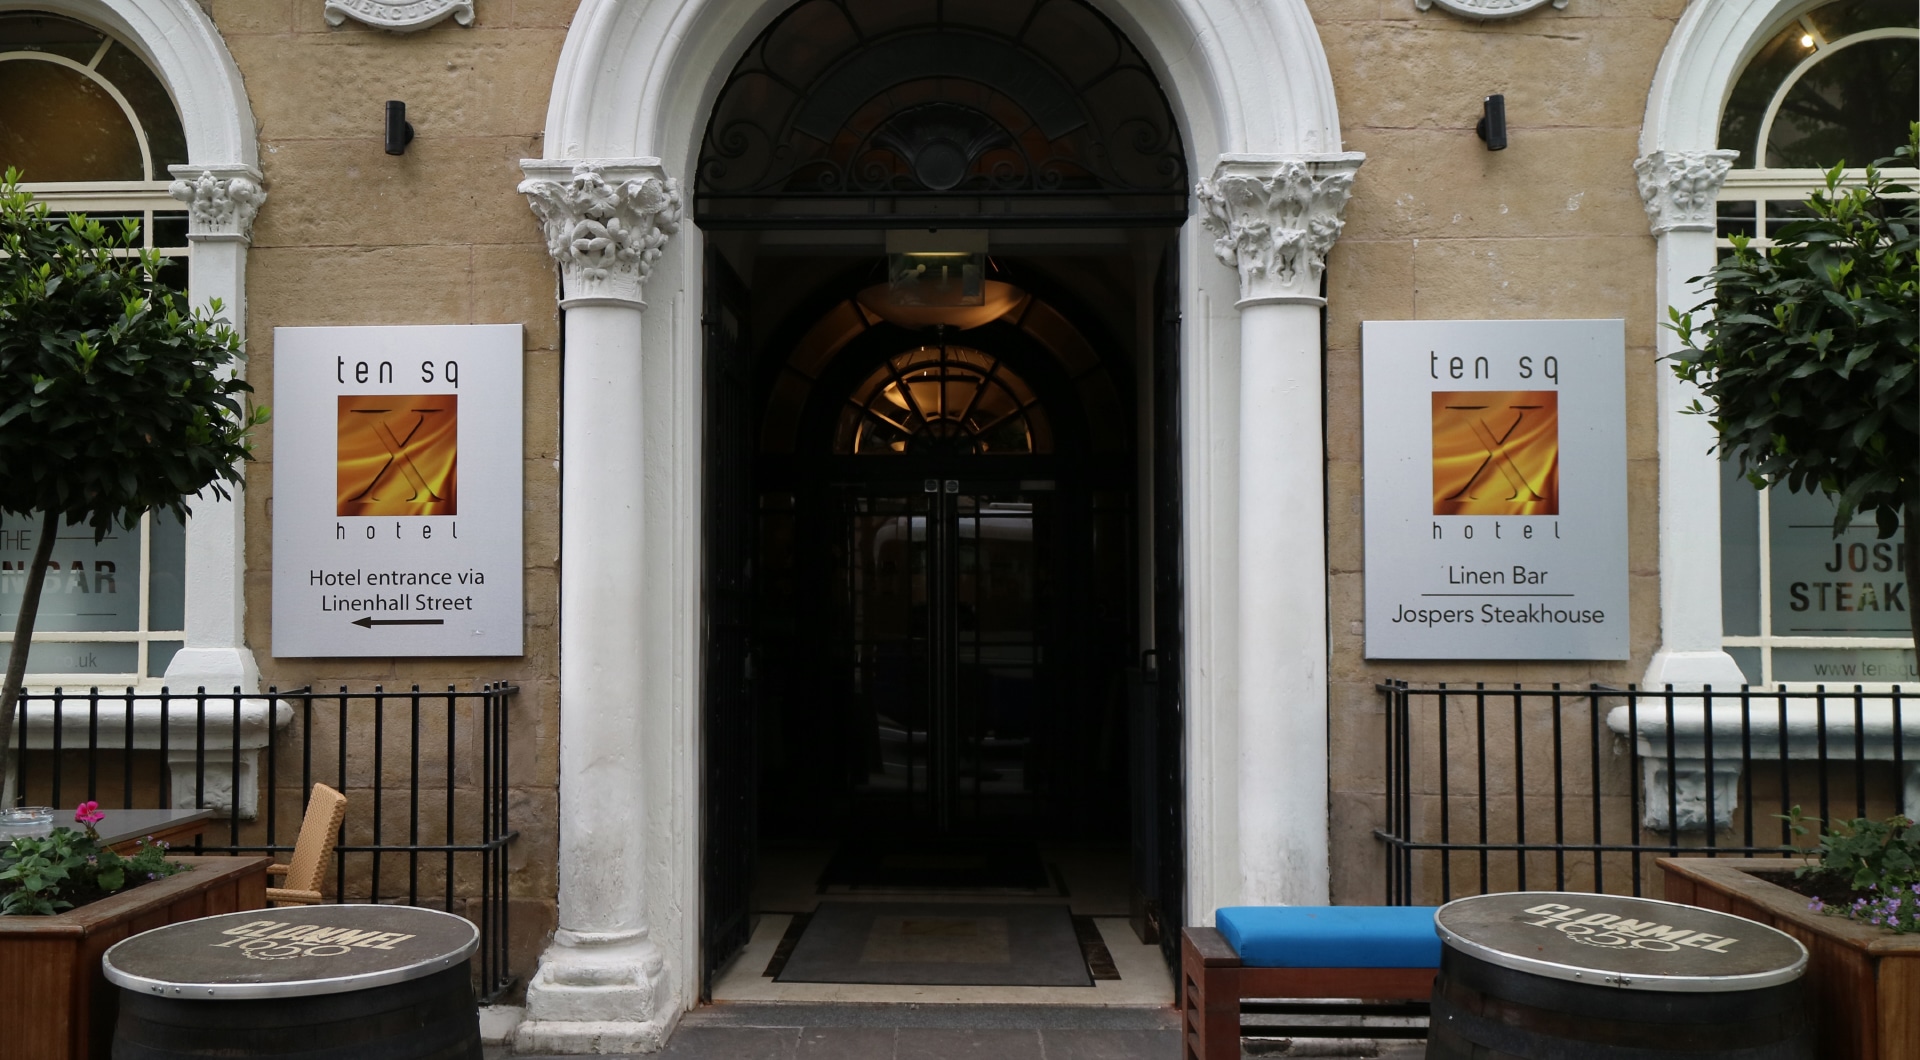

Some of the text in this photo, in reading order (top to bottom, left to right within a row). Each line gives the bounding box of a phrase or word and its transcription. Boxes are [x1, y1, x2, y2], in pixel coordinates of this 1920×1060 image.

[337, 355, 458, 388] ten sq
[1430, 350, 1559, 385] ten sq
[348, 408, 446, 503] X
[1444, 404, 1545, 502] X
[336, 521, 458, 540] hotel
[1432, 520, 1560, 540] hotel
[309, 568, 485, 586] Hotel entrance via
[1449, 565, 1549, 585] Linen Bar
[322, 593, 473, 612] Linenhall Street
[1391, 602, 1605, 628] Jospers Steakhouse
[222, 920, 417, 950] CLONMEL
[1523, 903, 1740, 953] CLONMEL
